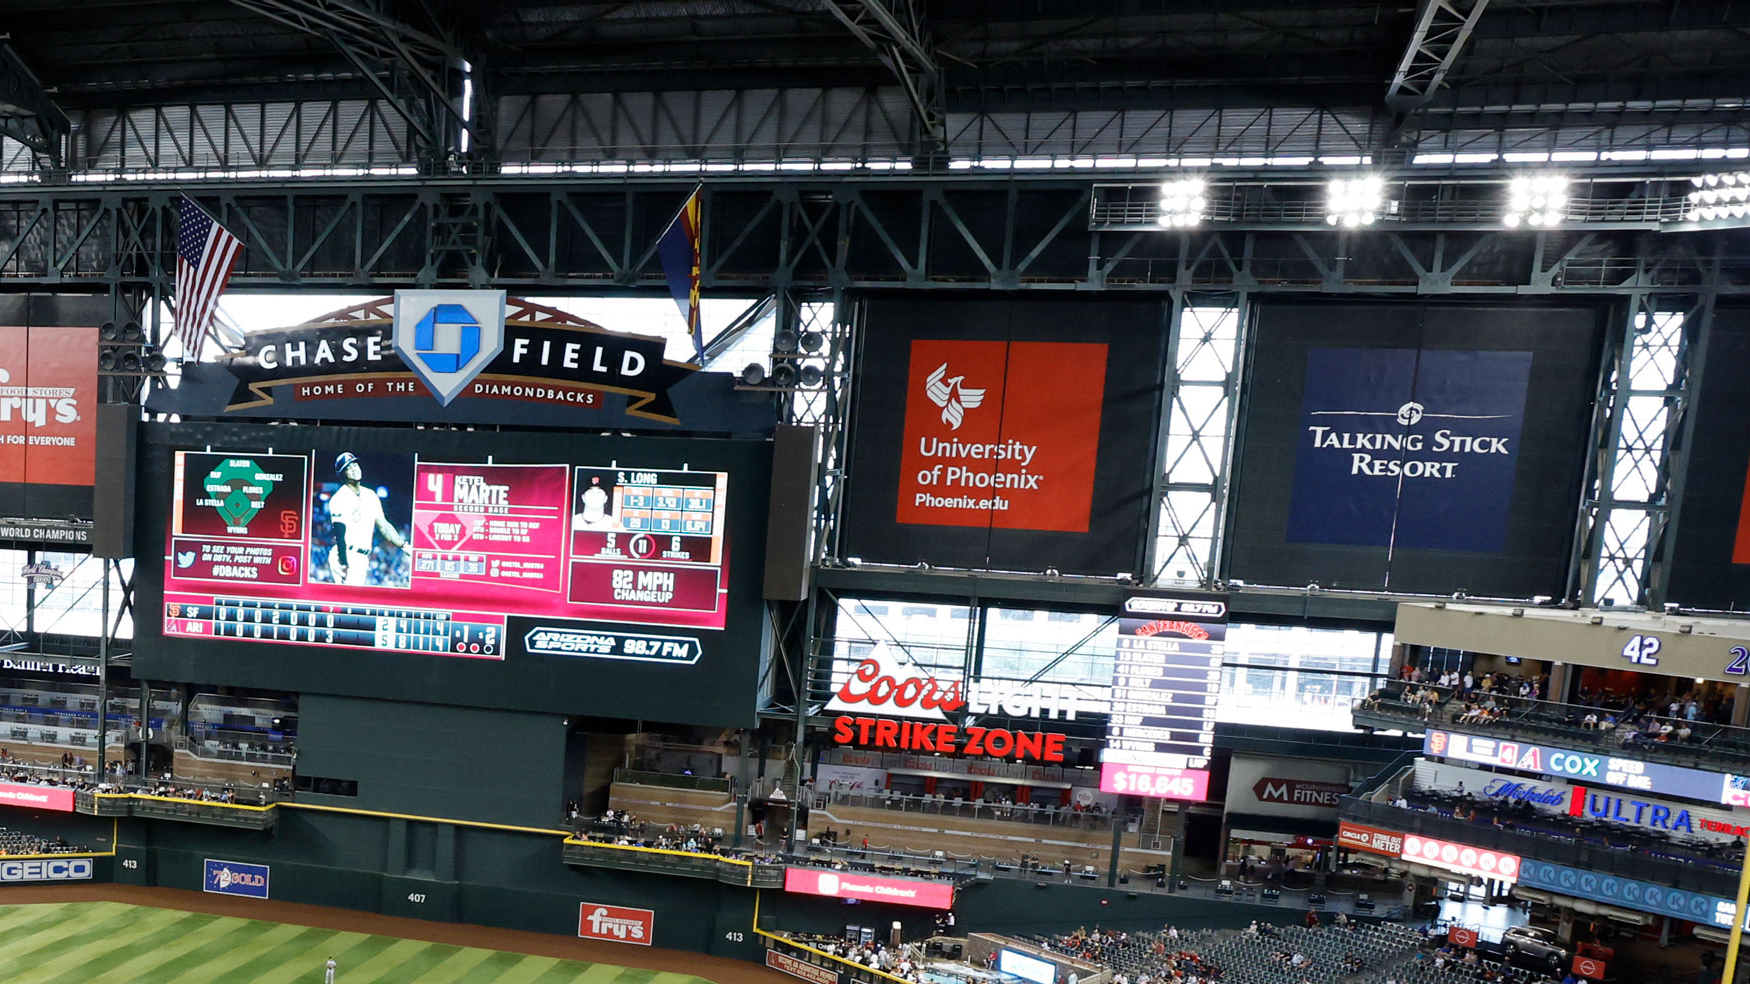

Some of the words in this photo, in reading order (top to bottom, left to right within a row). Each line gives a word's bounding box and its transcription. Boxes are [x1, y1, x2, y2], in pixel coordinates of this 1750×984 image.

[257, 336, 383, 370] CHASE
[511, 337, 646, 378] FIELD
[0, 388, 27, 396] FOOD
[32, 388, 71, 397] STORES
[301, 383, 345, 396] HOME
[356, 382, 375, 394] OF
[386, 381, 416, 392] THE
[474, 383, 596, 405] DIAMONDBACKS
[6, 434, 26, 444] FOR
[28, 435, 76, 446] EVERYONE
[1308, 426, 1424, 451] TALKING
[1432, 430, 1510, 455] STICK
[920, 436, 1038, 466] University
[1351, 453, 1458, 478] RESORT
[455, 475, 484, 486] KETEL
[630, 472, 658, 484] LONG
[918, 464, 944, 486] of
[428, 473, 443, 502] 4
[454, 484, 510, 506] MARTE
[914, 493, 1008, 510] Phoenix.edu
[453, 505, 485, 513] SECOND
[488, 506, 510, 514] BASE
[0, 526, 30, 538] WORLD
[33, 528, 87, 540] CHAMPIONS
[433, 522, 462, 534] TODAY
[234, 555, 252, 564] POST
[254, 556, 271, 564] WITH
[662, 550, 690, 560] STRIKES
[212, 564, 258, 578] #DBACKS
[612, 569, 634, 590] 82
[638, 570, 674, 592] MPH
[614, 588, 674, 603] CHANGEUP
[186, 606, 200, 618] SF
[186, 622, 203, 632] ARI
[532, 632, 616, 646] ARIZONA
[534, 640, 611, 654] SPORTS
[624, 640, 661, 655] 98.7
[661, 642, 690, 658] FM
[1622, 635, 1661, 666] 42
[837, 658, 966, 711] Coors
[968, 681, 1081, 720] LIGHT
[834, 716, 958, 753] STRIKE
[962, 726, 1066, 762] ZONE
[1549, 752, 1600, 778] COX
[1114, 772, 1194, 796] $16,645
[1483, 778, 1566, 806] Michelob
[1588, 793, 1694, 834] ULTRA
[1699, 817, 1750, 838] TERRAC
[1372, 840, 1402, 854] METER
[1, 860, 90, 880] GEICO
[122, 860, 138, 869] 413
[841, 882, 874, 893] Phoenix
[408, 893, 426, 903] 407
[587, 908, 644, 939] fry's
[726, 932, 743, 942] 413
